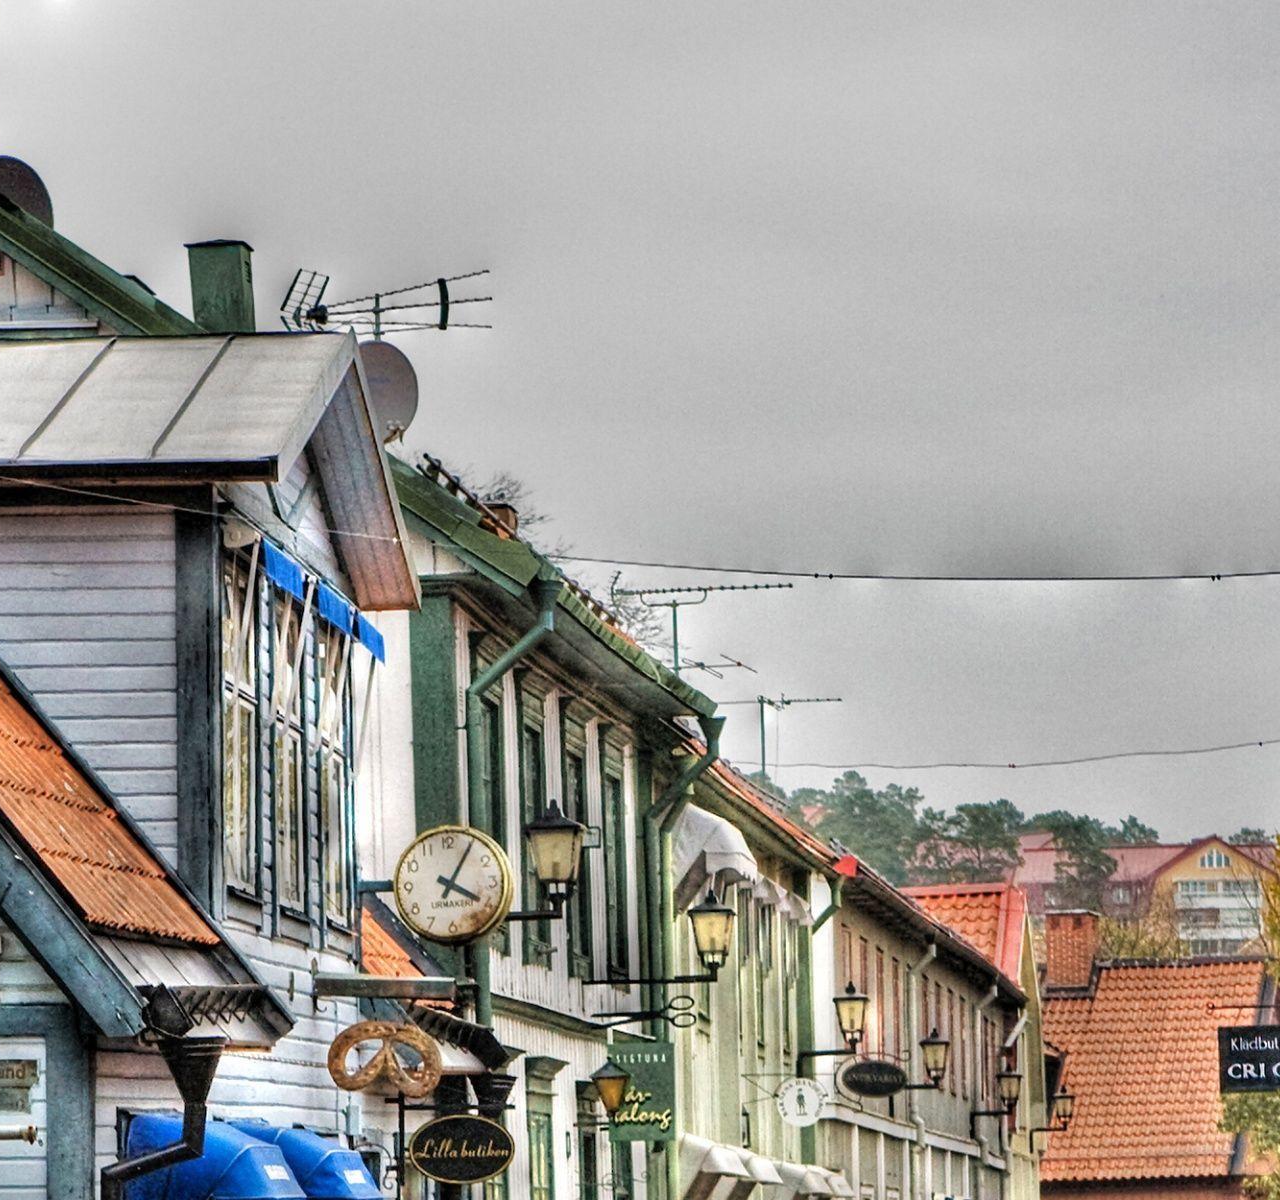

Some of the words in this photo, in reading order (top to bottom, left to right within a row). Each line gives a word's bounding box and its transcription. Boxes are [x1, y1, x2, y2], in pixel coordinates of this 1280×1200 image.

[422, 843, 433, 857] 11
[441, 836, 455, 850] 12
[407, 858, 419, 873] 10
[480, 854, 491, 868] 2
[403, 881, 414, 895] 9
[488, 875, 498, 889] 3
[411, 902, 420, 915] 8
[427, 916, 436, 932] 7
[448, 920, 458, 934] 6
[616, 1053, 666, 1064] SIGTUNA
[1227, 1062, 1266, 1079] CRI
